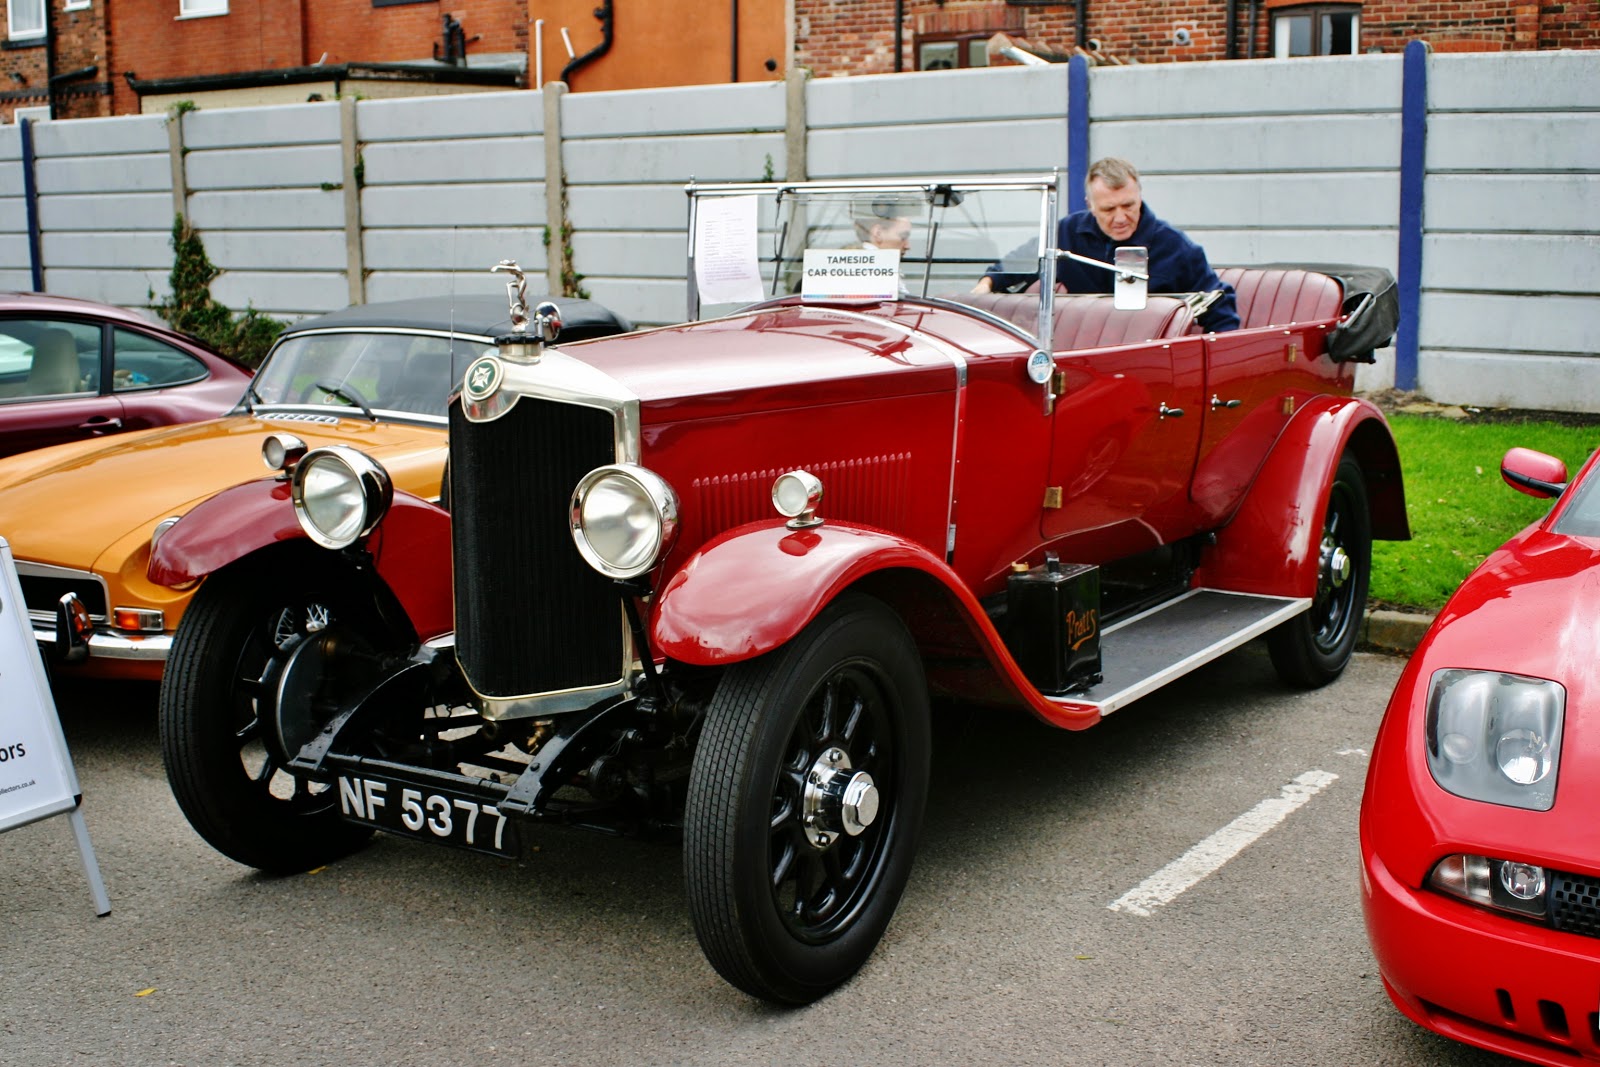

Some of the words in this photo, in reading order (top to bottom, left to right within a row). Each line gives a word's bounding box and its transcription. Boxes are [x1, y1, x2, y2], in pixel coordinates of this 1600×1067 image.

[827, 256, 875, 264] TAMESIDE
[808, 268, 827, 277] CAR
[830, 268, 894, 277] COLLECTORS
[338, 776, 387, 821] NF
[401, 788, 507, 850] 5377
